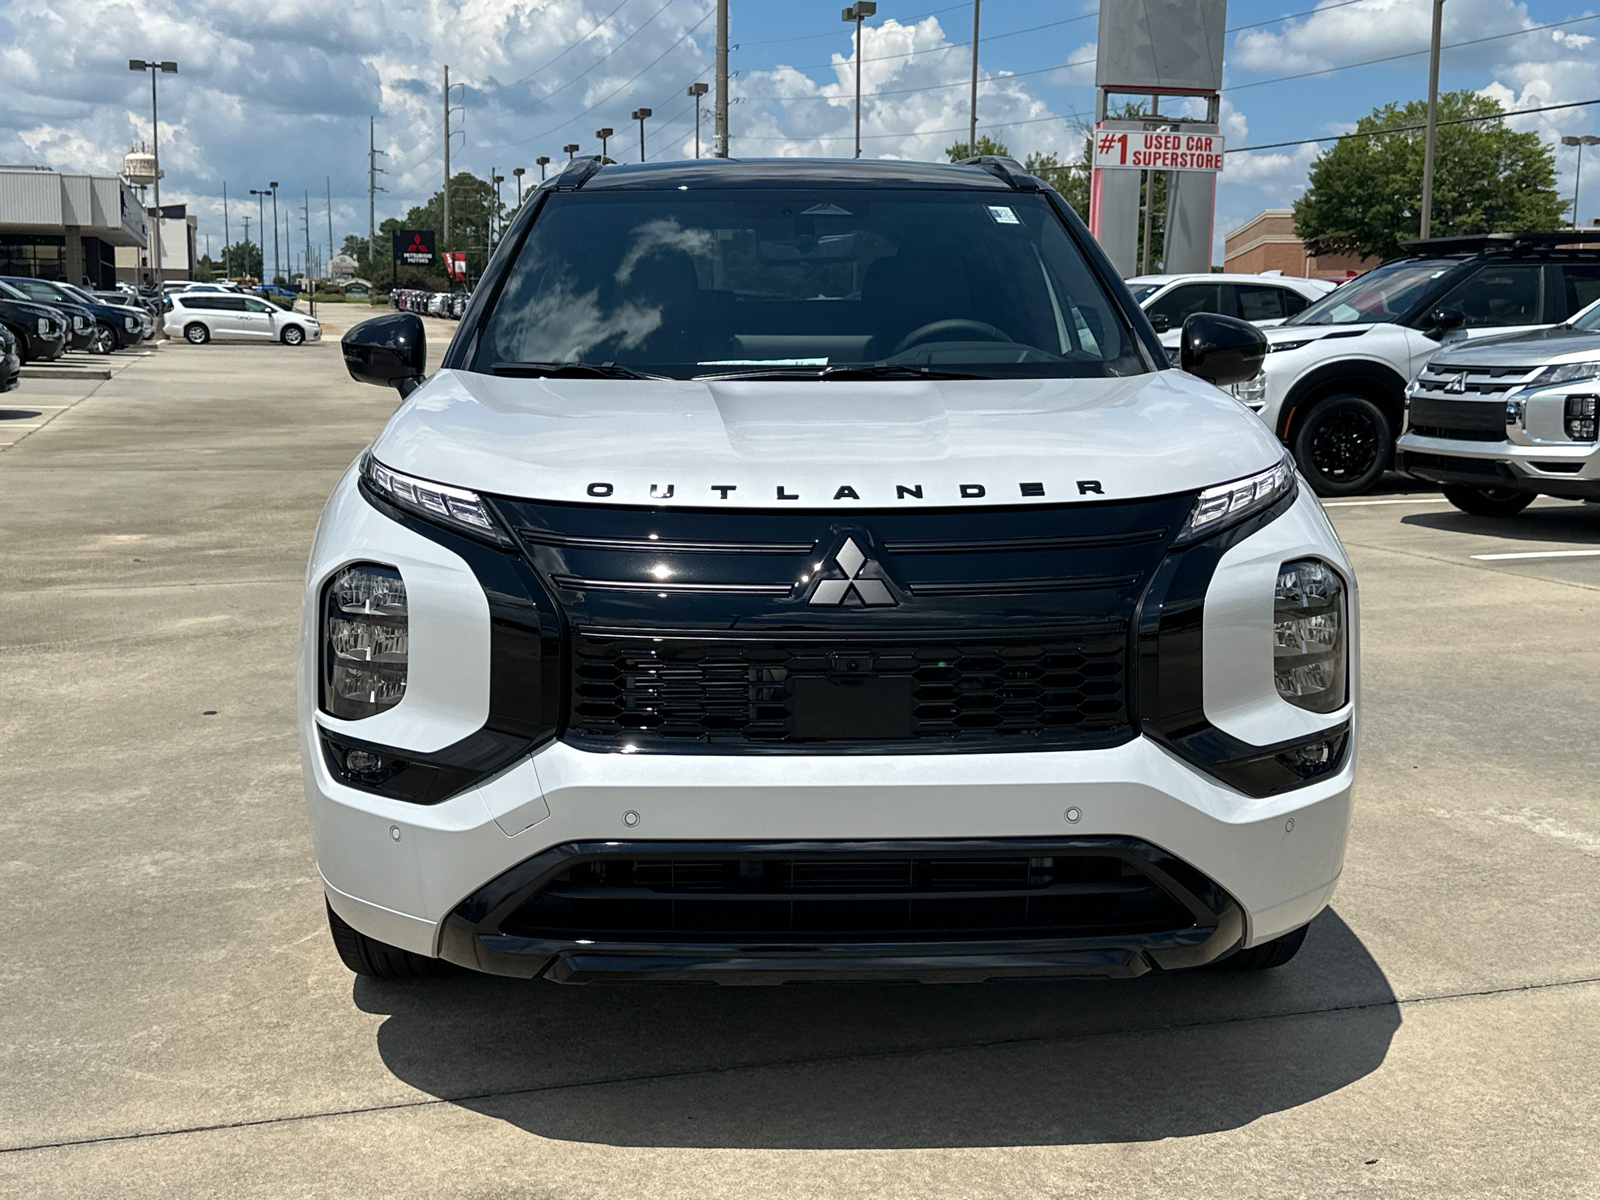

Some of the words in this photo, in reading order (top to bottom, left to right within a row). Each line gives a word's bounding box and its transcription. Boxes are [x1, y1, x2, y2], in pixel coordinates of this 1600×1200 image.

[1098, 133, 1128, 165] #1
[1144, 134, 1181, 150] USED
[1186, 136, 1213, 152] CAR
[1132, 150, 1222, 169] SUPERSTORE
[586, 480, 1106, 500] OUTLANDER
